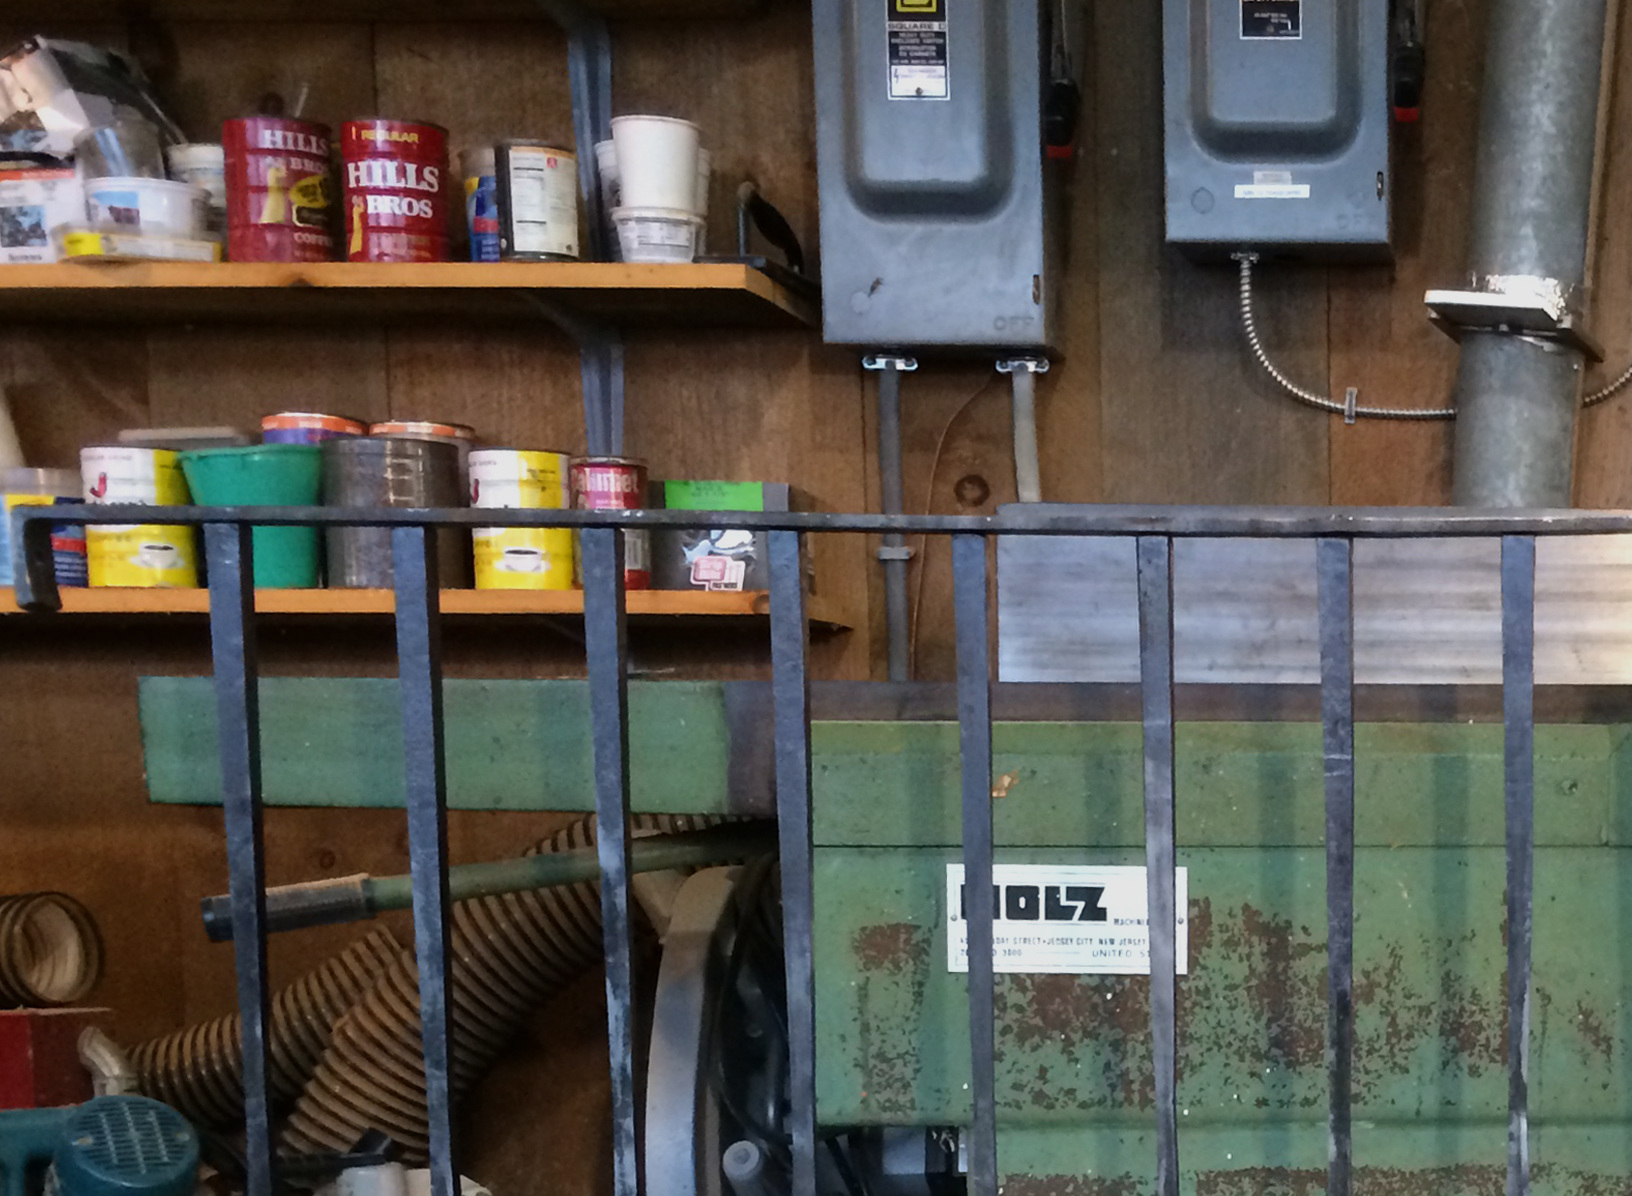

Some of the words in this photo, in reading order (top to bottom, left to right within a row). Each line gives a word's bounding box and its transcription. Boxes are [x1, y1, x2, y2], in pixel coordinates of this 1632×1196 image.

[261, 129, 328, 156] HILLS
[348, 158, 440, 193] HILLS
[366, 195, 434, 219] BROS
[961, 883, 1108, 922] OLZ
